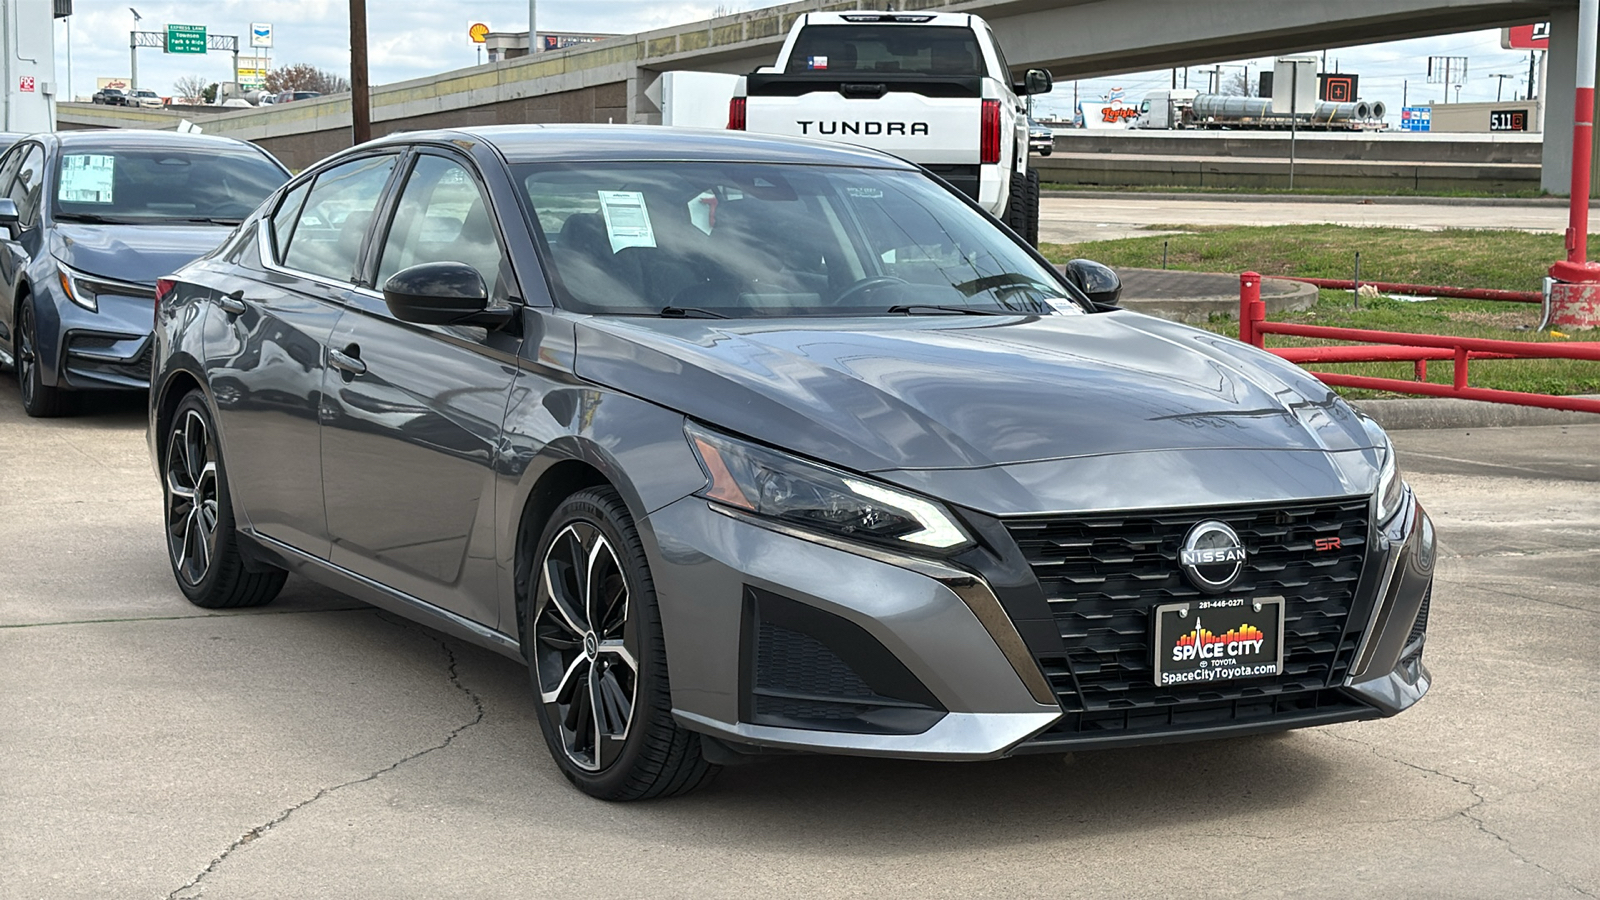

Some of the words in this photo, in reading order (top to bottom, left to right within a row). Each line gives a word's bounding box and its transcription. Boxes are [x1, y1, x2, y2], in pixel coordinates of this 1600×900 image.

[20, 76, 34, 86] FDC
[796, 120, 929, 136] TUNDRA
[1315, 536, 1342, 551] SR
[1182, 548, 1246, 564] NISSAN
[1198, 599, 1244, 610] 281-446-0271
[1172, 642, 1224, 661] SPACE
[1227, 639, 1264, 656] CITY
[1210, 658, 1237, 668] TOYOTA
[1161, 664, 1277, 685] SpaceCityToyota.com
